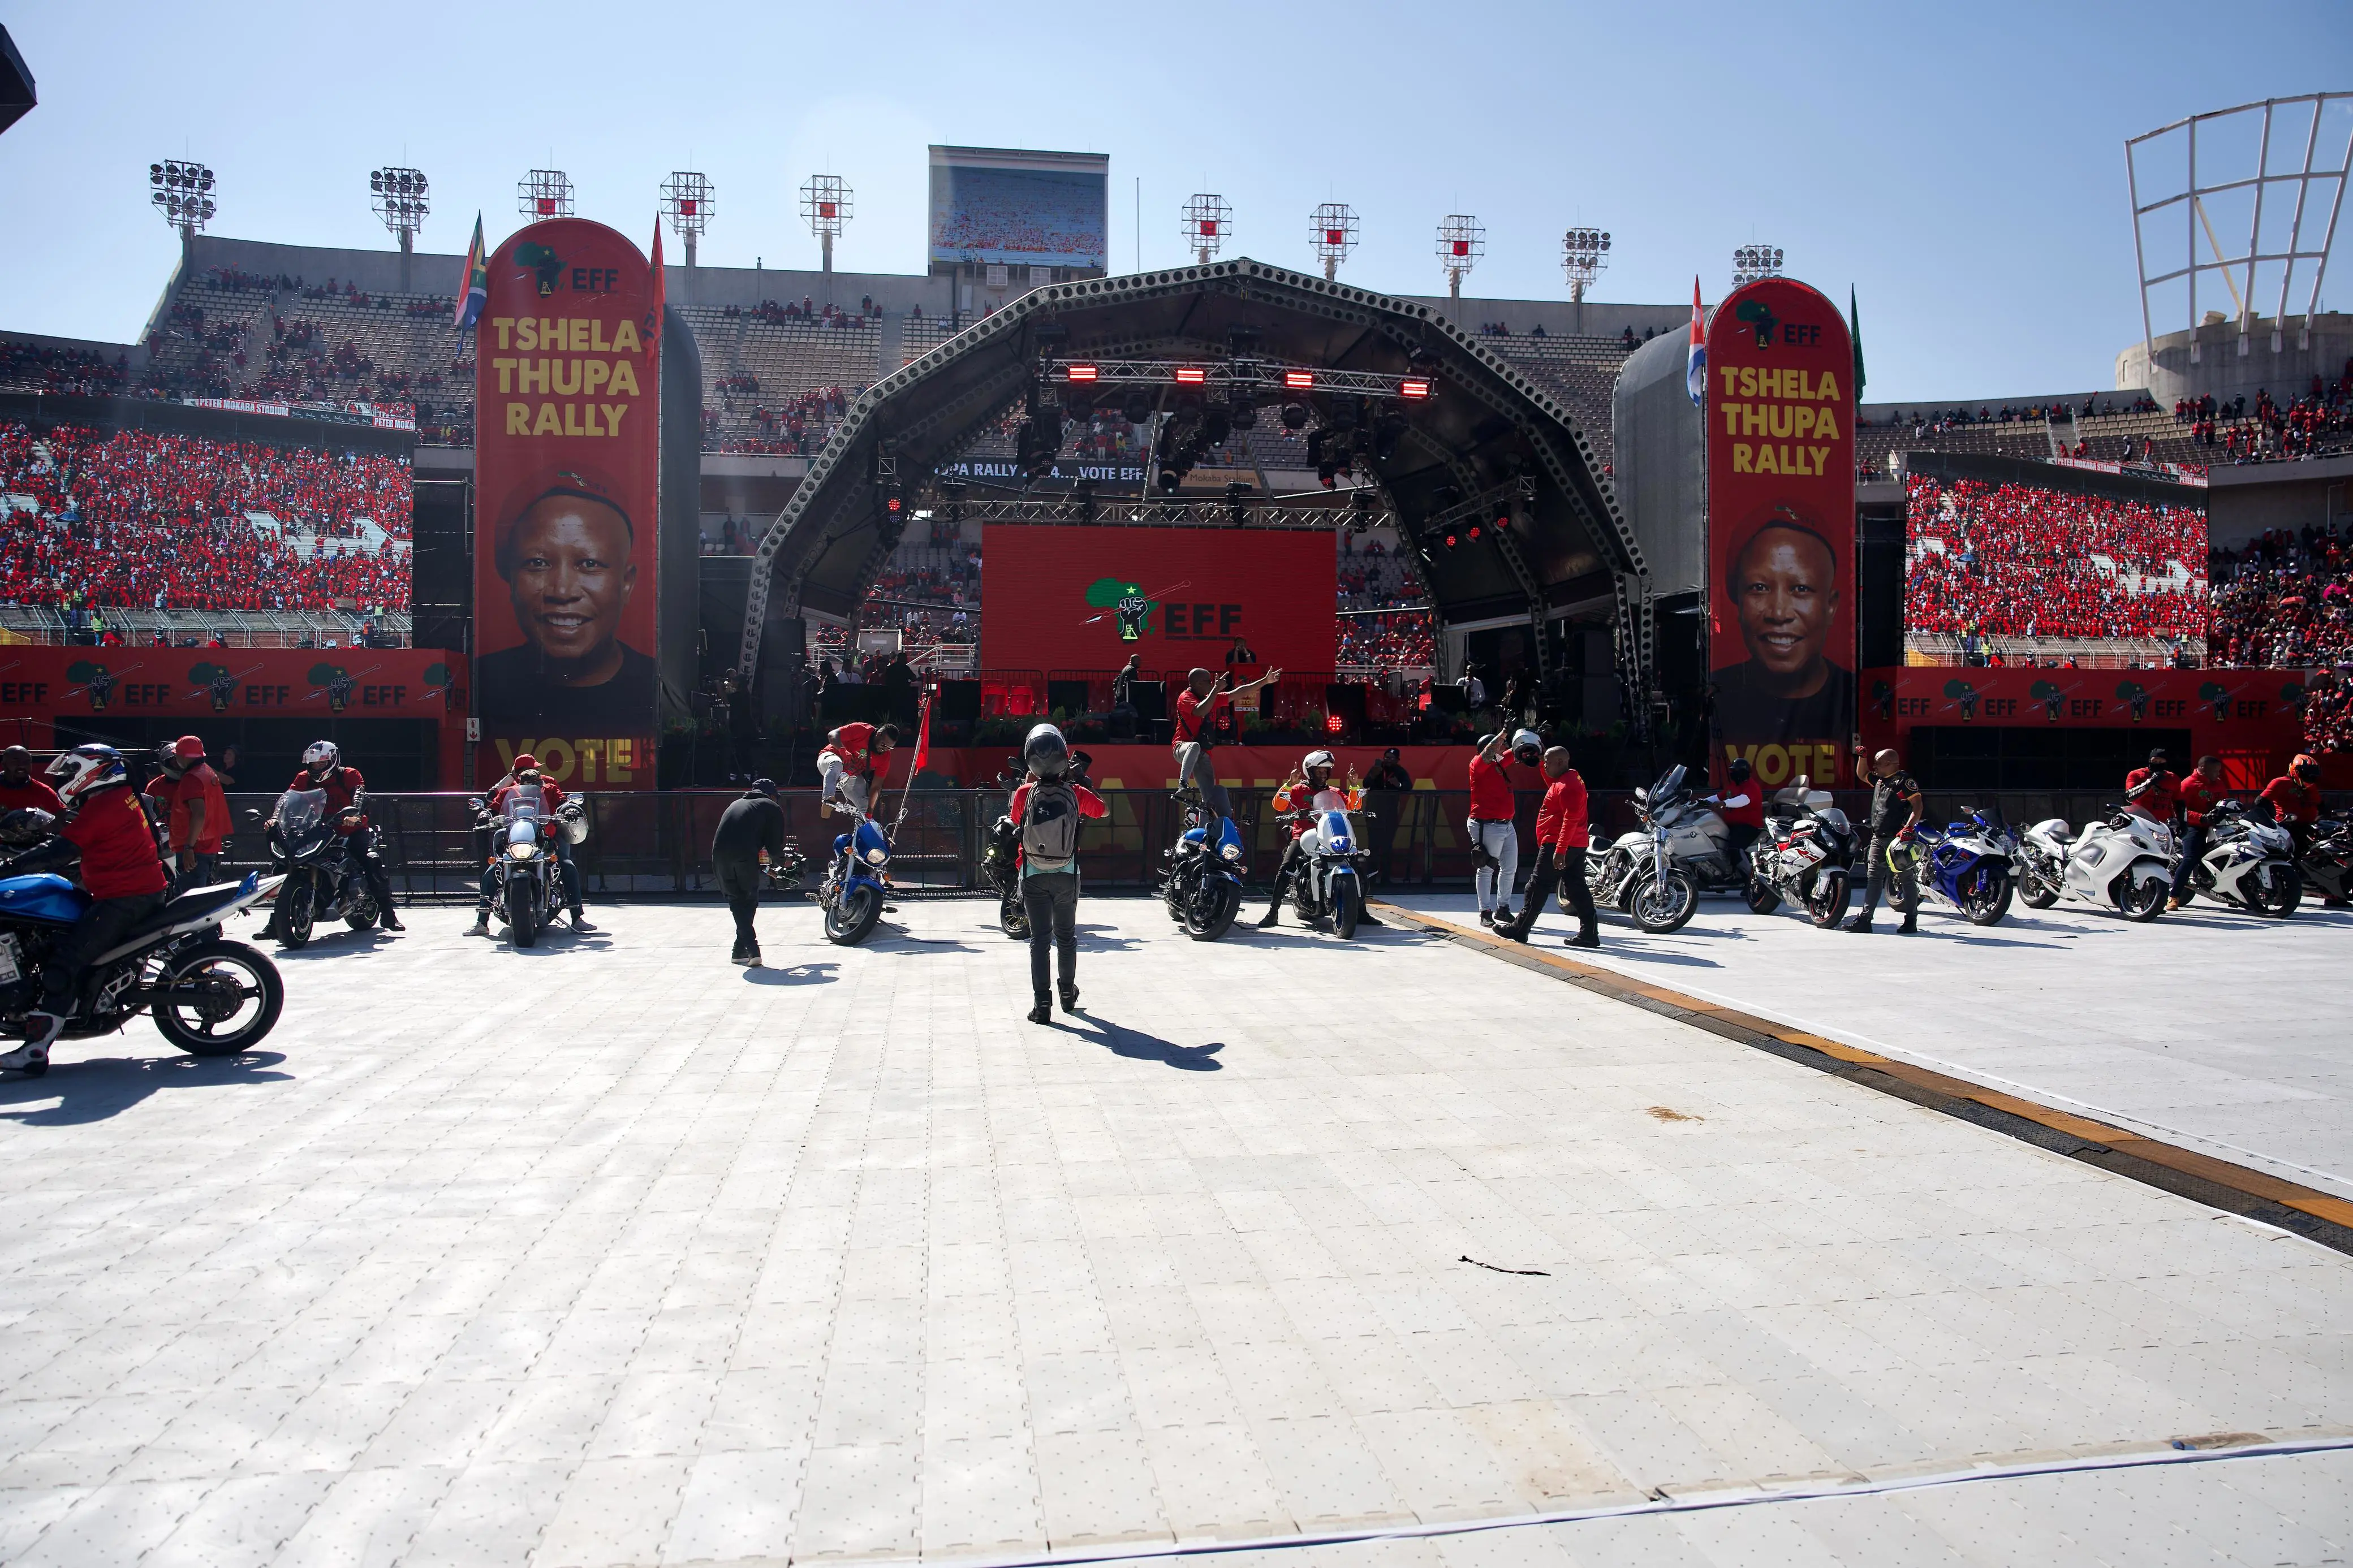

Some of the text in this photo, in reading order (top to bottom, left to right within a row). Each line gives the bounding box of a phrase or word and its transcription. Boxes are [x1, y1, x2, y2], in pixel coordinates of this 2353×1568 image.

[572, 268, 618, 290] EFF
[492, 317, 641, 352] TSHELA
[1785, 324, 1821, 344] EFF
[492, 358, 640, 396] THUPA
[1720, 366, 1841, 401] TSHELA
[199, 398, 289, 416] PETER MOKABA STADIUM
[374, 417, 394, 428] PETER
[506, 403, 628, 437] RALLY
[1721, 403, 1840, 440] THUPA
[1733, 443, 1830, 476] RALLY
[2097, 462, 2120, 474] STADIUM
[974, 463, 1018, 477] RALLY
[1079, 466, 1115, 480] VOTE
[1190, 474, 1221, 482] Mokaba
[1165, 604, 1242, 634] EFF
[2, 683, 48, 703] EFF
[124, 684, 170, 705] EFF
[246, 686, 290, 705] EFF
[363, 686, 407, 705] EFF
[1898, 698, 1930, 715] EFF
[1985, 699, 2017, 716] EFF
[2071, 700, 2102, 716] EFF
[2155, 700, 2186, 716] EFF
[2238, 701, 2268, 716] EFF
[495, 737, 632, 783] VOTE
[1725, 744, 1834, 785] VOTE
[70, 775, 87, 792] ZEUS
[2209, 889, 2239, 905] SUZUKI
